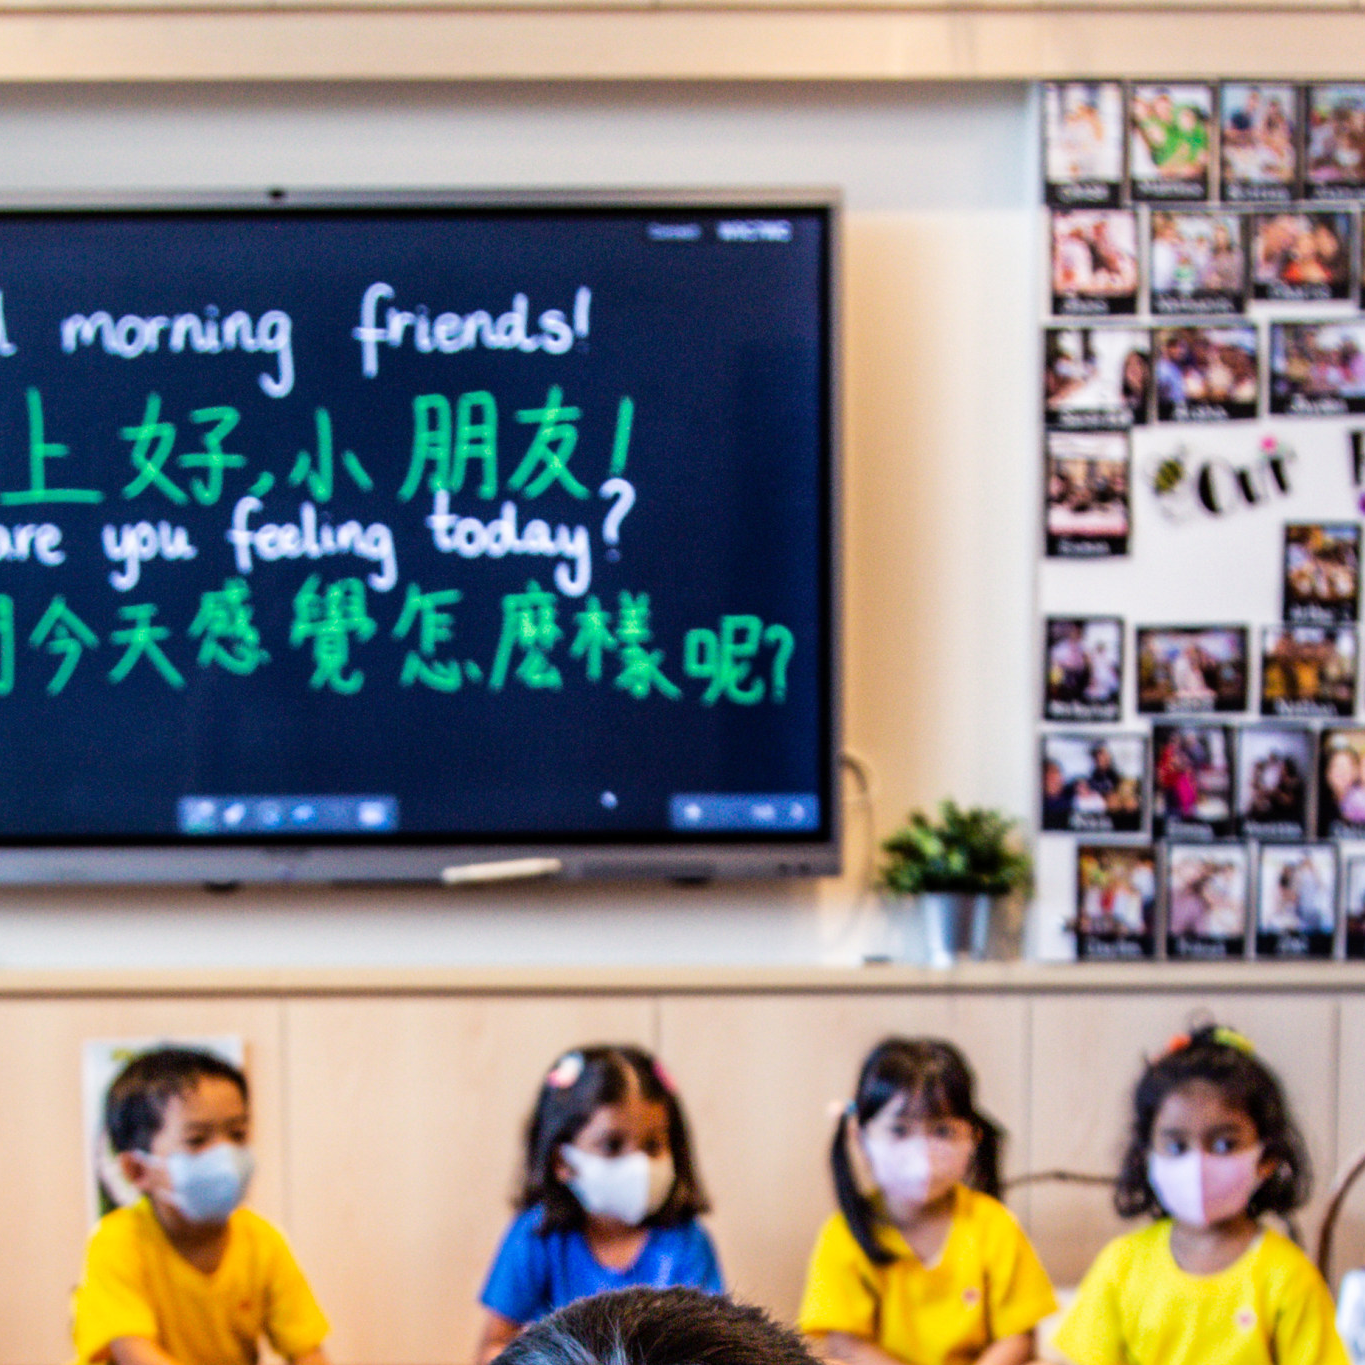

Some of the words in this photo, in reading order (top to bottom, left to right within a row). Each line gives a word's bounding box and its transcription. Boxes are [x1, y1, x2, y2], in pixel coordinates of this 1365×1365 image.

[60, 304, 295, 398] morning
[351, 281, 592, 379] friends!
[101, 520, 198, 592] you
[226, 496, 398, 592] feeling
[425, 478, 636, 597] today?
